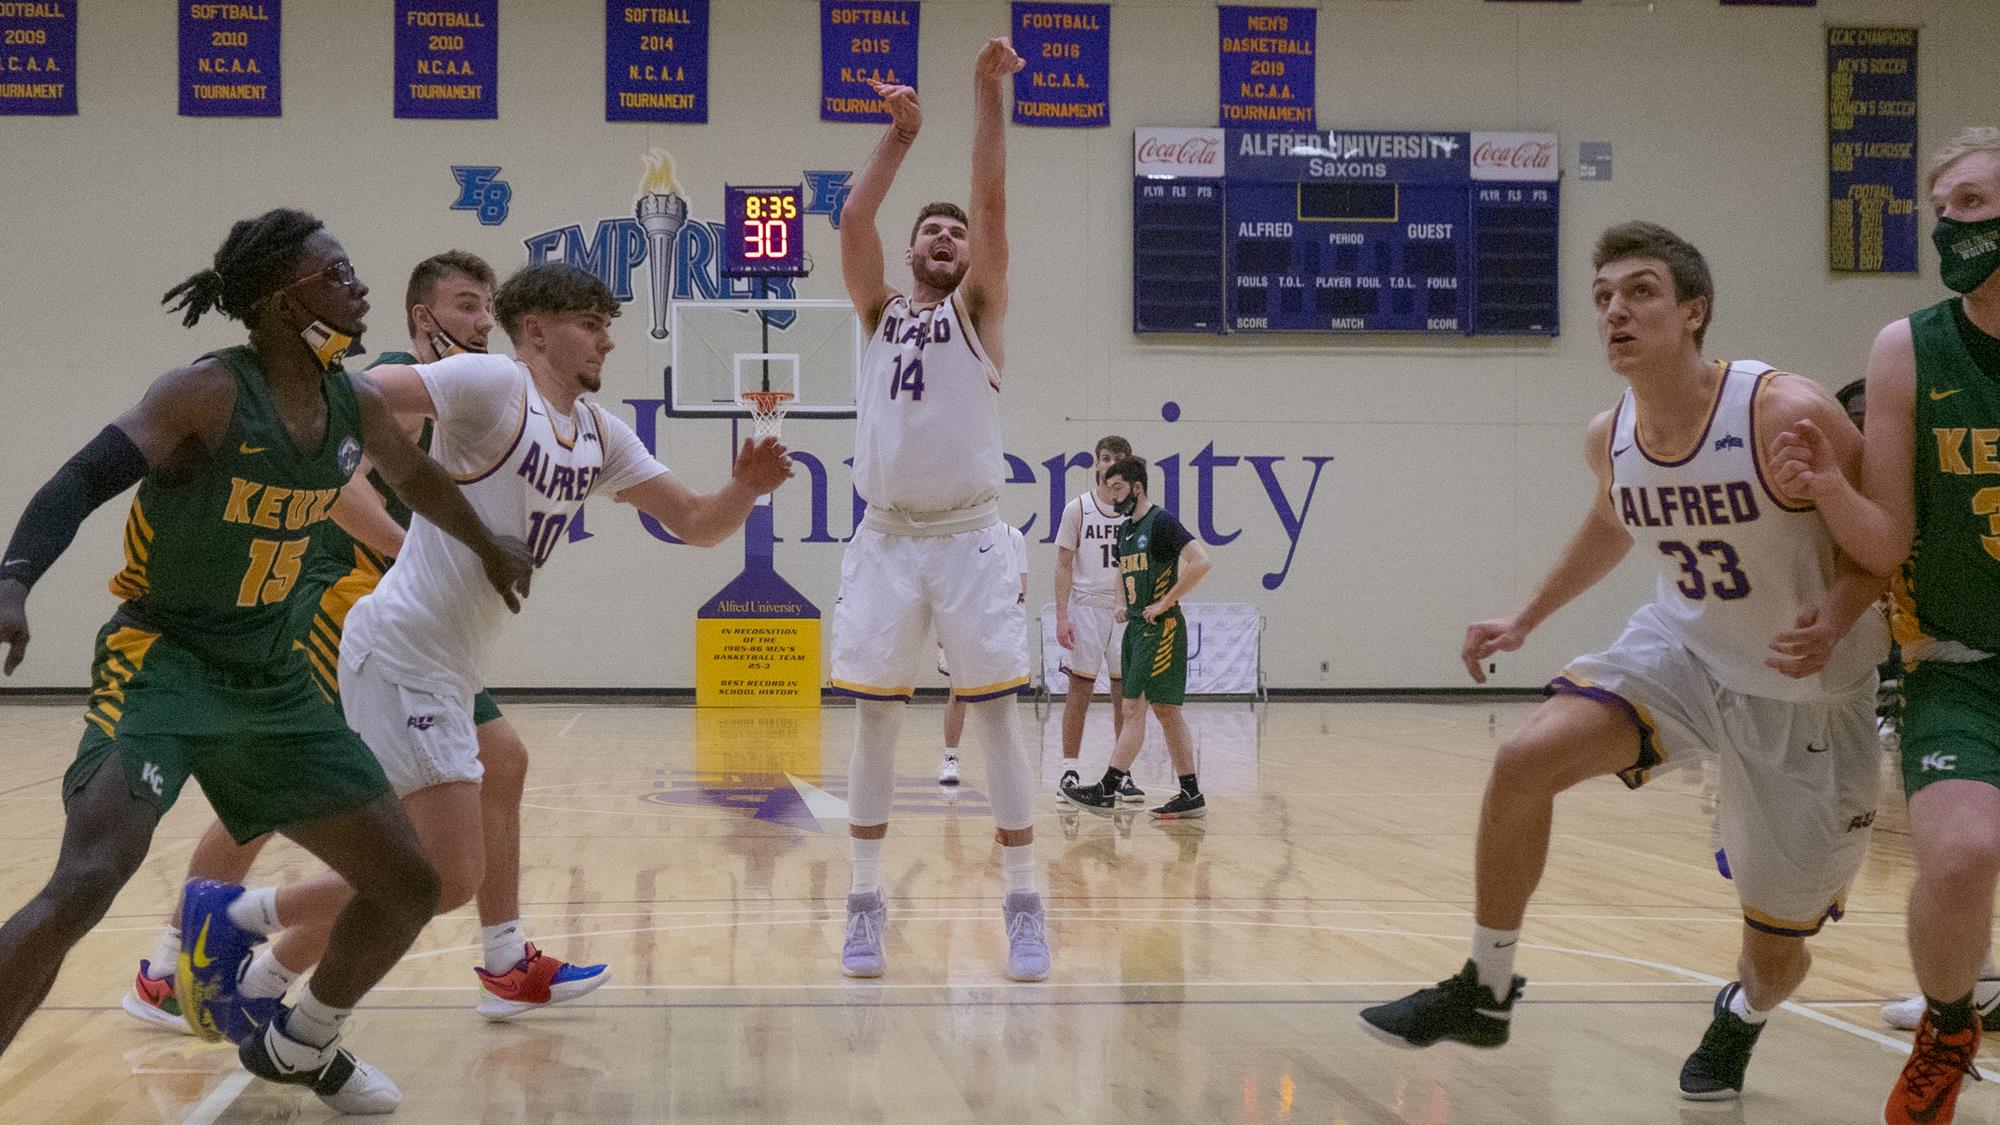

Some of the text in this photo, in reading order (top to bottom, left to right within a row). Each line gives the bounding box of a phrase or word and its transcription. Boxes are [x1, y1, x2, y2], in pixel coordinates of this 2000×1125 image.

[0, 3, 64, 18] OTBALL
[191, 5, 268, 20] SOFTBALL
[624, 8, 690, 24] SOFTBALL
[831, 9, 909, 25] SOFTBALL
[407, 11, 484, 27] FOOTBALL
[1023, 14, 1099, 30] FOOTBALL
[1248, 16, 1288, 32] MEN'S
[5, 30, 46, 45] 2009
[212, 31, 248, 47] 2010
[428, 36, 464, 50] 2010
[641, 36, 673, 51] 2014
[851, 38, 890, 53] 2015
[1042, 43, 1080, 58] 2016
[1223, 38, 1312, 55] BASKETBALL
[0, 56, 60, 72] .C.A.A.
[199, 58, 261, 73] N.C.A.A.
[417, 60, 474, 75] N.C.A.A.
[1251, 60, 1285, 76] 2019
[1033, 73, 1088, 88] N.C.A.A.
[0, 84, 65, 99] URNAMENT
[192, 84, 268, 100] TOURNAMENT
[409, 84, 482, 99] TOURNAMENT
[1241, 83, 1295, 99] N.C.A.A.
[619, 92, 695, 109] TOURNAMENT
[826, 97, 890, 114] TOURNAM
[1018, 101, 1104, 118] TOURNAMENT
[1223, 104, 1313, 122] TOURNAMENT
[1239, 134, 1457, 159] ALFRED UNIVERSITY
[1309, 158, 1387, 178] Saxons
[1172, 186, 1187, 197] FLS
[1197, 186, 1213, 198] PTS
[746, 196, 797, 219] 8:35
[1238, 222, 1293, 237] ALFRED
[1407, 223, 1453, 239] GUEST
[743, 220, 788, 258] 30
[1329, 233, 1364, 245] PERIOD
[1237, 276, 1268, 287] FOULS
[1279, 277, 1305, 287] T.O.L.
[1316, 277, 1381, 288] PLAYER FOUL
[1390, 277, 1416, 288] T.O.L.
[1427, 277, 1457, 289] FOULS
[1237, 318, 1268, 329] SCORE
[1332, 318, 1364, 329] MATCH
[1427, 319, 1458, 330] SCORE
[889, 353, 925, 401] 14
[223, 476, 339, 530] KEUK
[1620, 480, 1760, 528] ALFRED
[527, 511, 567, 569] 10
[1085, 525, 1120, 539] ALFR
[237, 536, 310, 608] 15
[1658, 540, 1752, 601] 33
[717, 601, 802, 615] Alfred University
